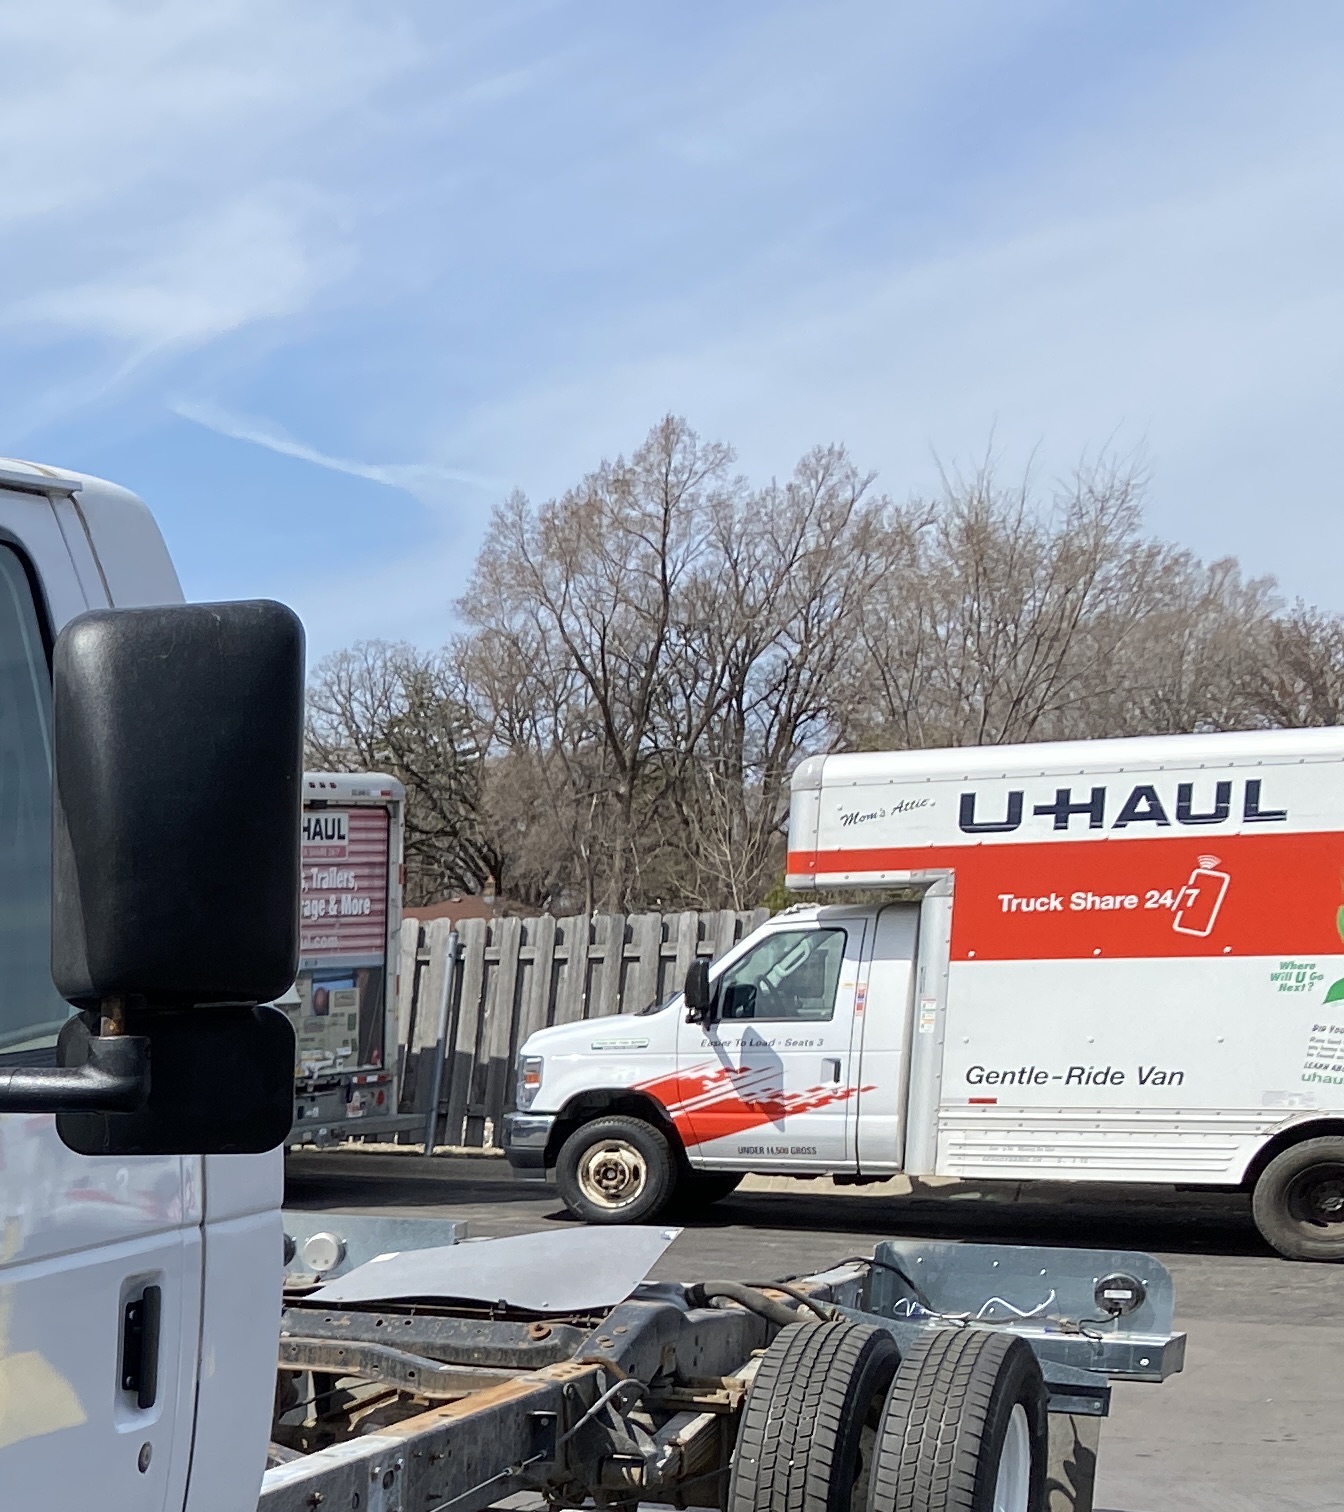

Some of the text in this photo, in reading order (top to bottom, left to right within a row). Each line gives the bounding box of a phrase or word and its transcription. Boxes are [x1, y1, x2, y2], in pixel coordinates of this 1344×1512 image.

[839, 798, 931, 828] Mom's Attic
[959, 779, 1288, 834] U-HAUL
[310, 867, 358, 892] Trailers,
[328, 893, 338, 916] &
[341, 894, 371, 915] More
[997, 885, 1201, 912] Truck Share 24/7
[1279, 960, 1316, 970] Where
[1270, 971, 1324, 984] Will U Go
[1278, 981, 1315, 992] Next?
[700, 1038, 824, 1048] Easier To Load Seats 3
[965, 1065, 1185, 1086] Gentle-Ride Van
[737, 1146, 764, 1154] UNDER
[790, 1146, 817, 1155] GROSS
